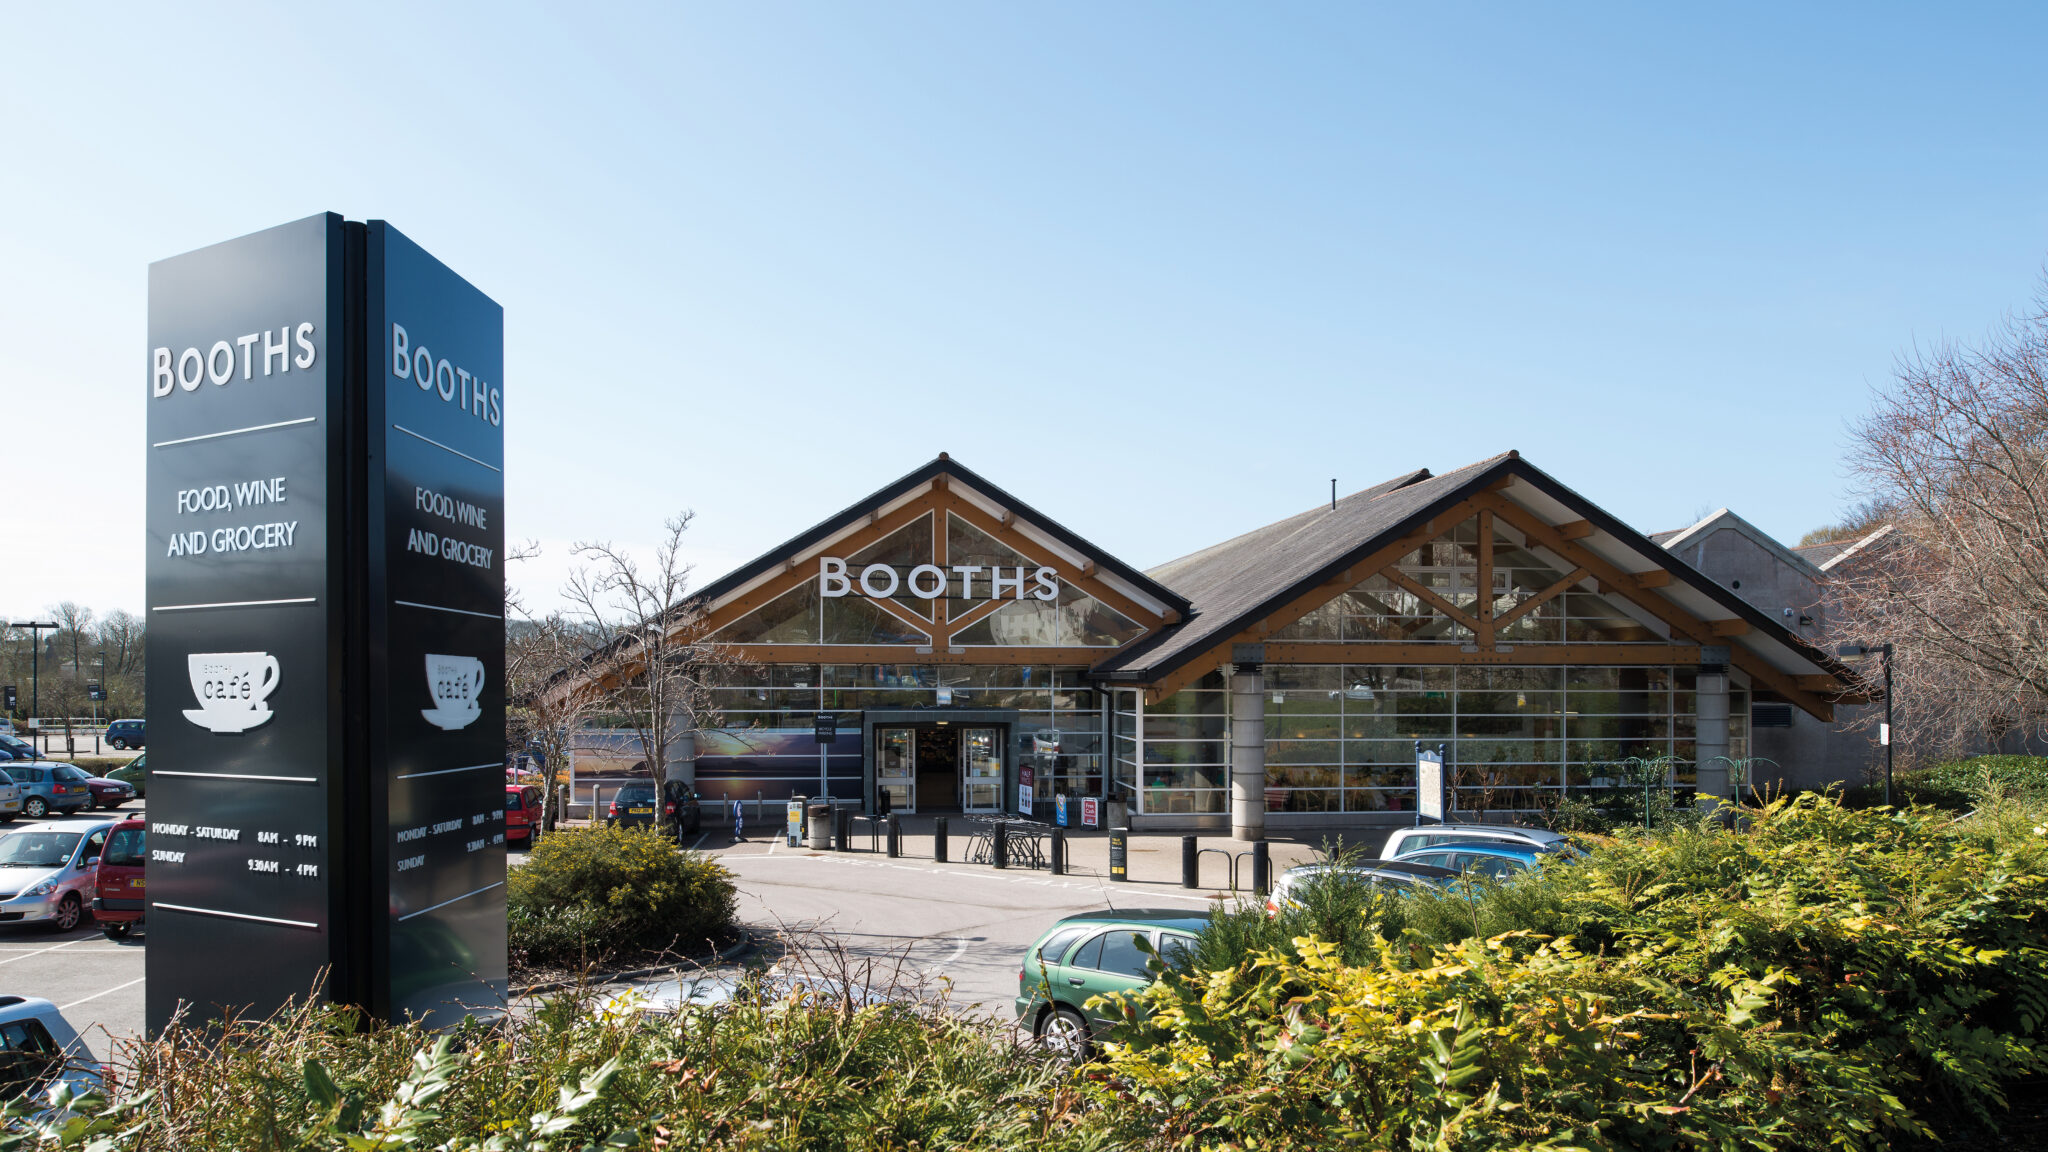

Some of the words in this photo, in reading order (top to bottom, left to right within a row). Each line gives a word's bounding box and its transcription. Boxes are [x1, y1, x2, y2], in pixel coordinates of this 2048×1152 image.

[153, 321, 318, 399] BOOTHS
[391, 321, 501, 428] BOOTHS
[177, 483, 233, 515] FOOD,
[234, 476, 287, 507] WINE
[415, 487, 455, 524] FOOD,
[454, 503, 488, 531] WINE
[167, 530, 209, 557] AND
[211, 520, 298, 553] GROCERY
[407, 530, 439, 557] AND
[441, 537, 494, 571] GROCERY
[819, 556, 1060, 602] BOOTHS
[204, 671, 251, 700] café
[437, 673, 468, 700] café
[152, 822, 189, 836] MONDAY
[195, 826, 241, 841] SATURDAY
[257, 831, 279, 844] 8AM
[396, 826, 428, 843] MONDAY
[432, 818, 463, 835] SATURDAY
[151, 849, 186, 863] SUNDAY
[296, 863, 318, 877] 4PM
[396, 854, 425, 872] SUNDAY
